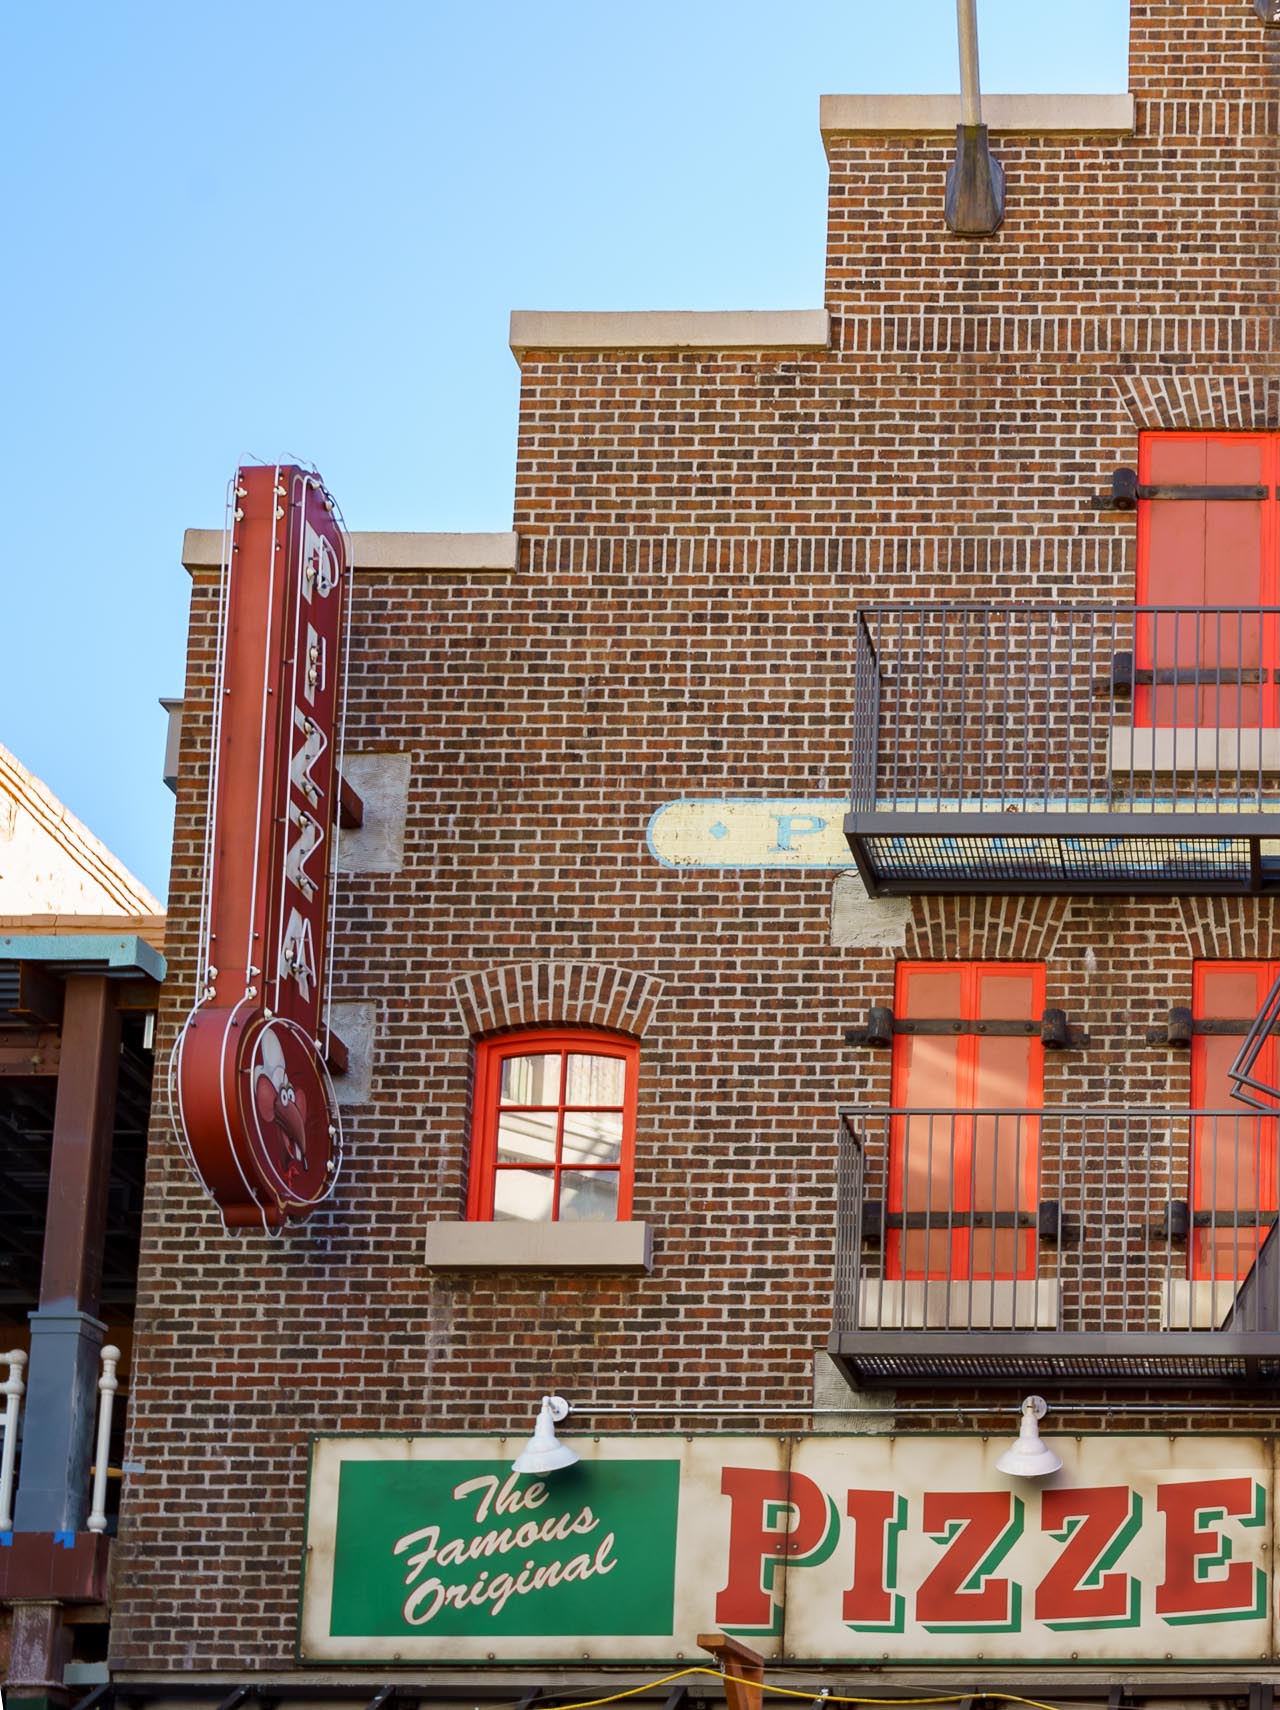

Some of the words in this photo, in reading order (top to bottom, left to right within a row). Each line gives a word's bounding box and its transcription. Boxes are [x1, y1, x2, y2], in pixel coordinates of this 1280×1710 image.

[281, 519, 340, 1003] PIZZA
[453, 1472, 550, 1524] The
[392, 1505, 601, 1585] Famous
[402, 1533, 618, 1626] Original
